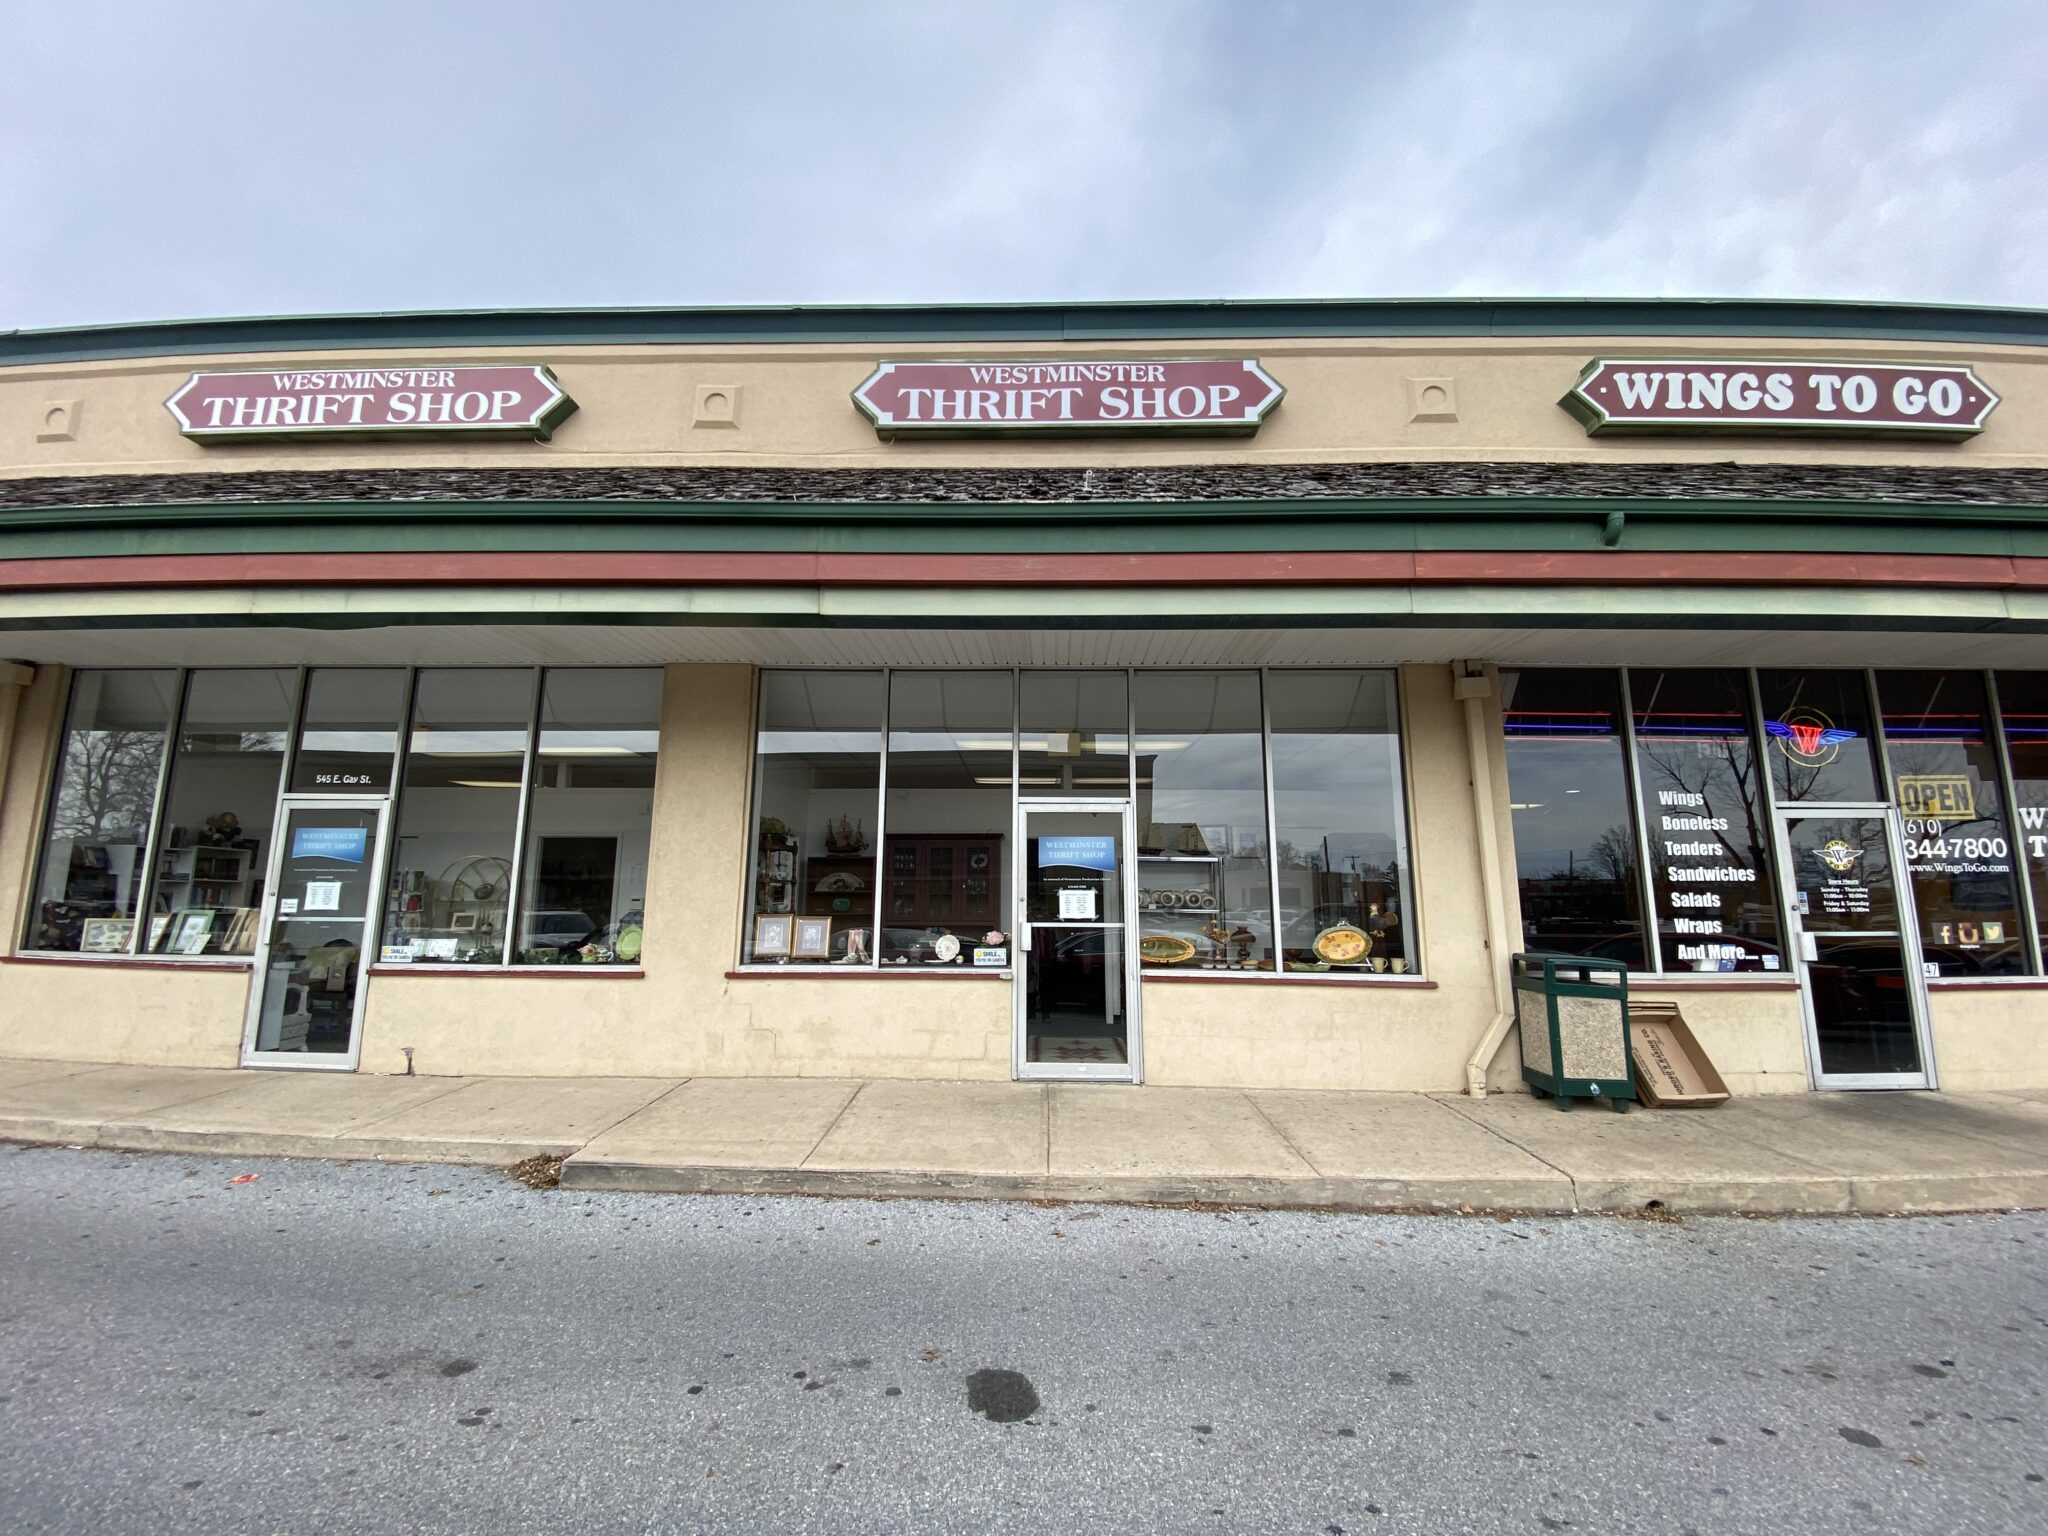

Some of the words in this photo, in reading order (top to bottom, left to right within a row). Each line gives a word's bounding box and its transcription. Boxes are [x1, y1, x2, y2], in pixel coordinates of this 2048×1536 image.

[272, 370, 456, 391] WESTMINSTER
[969, 364, 1166, 385] WESTMINSTER
[897, 387, 1083, 420] THRIFT
[1098, 384, 1241, 419] SHOP
[1612, 371, 1795, 411] WINGS
[1808, 373, 1878, 413] TO
[1892, 376, 1963, 417] GO
[202, 393, 376, 427] THRIFT
[385, 389, 522, 425] SHOP
[315, 774, 331, 784] 545
[342, 774, 359, 784] Gay
[1658, 791, 1704, 806] Wings
[1903, 783, 1970, 812] OPEN
[1661, 815, 1728, 831] Boneless
[1901, 818, 1942, 837] (610)
[1046, 841, 1107, 849] WESTMINSTER
[1664, 841, 1723, 856] Tenders
[1047, 851, 1080, 859] THRIFT
[1081, 851, 1106, 859] SHOP
[1667, 866, 1756, 882] Sandwiches
[1907, 862, 2010, 874] www.WingsToGo.com
[1671, 892, 1721, 908] Salads
[1674, 918, 1722, 935] Wraps
[1678, 944, 1706, 960] And
